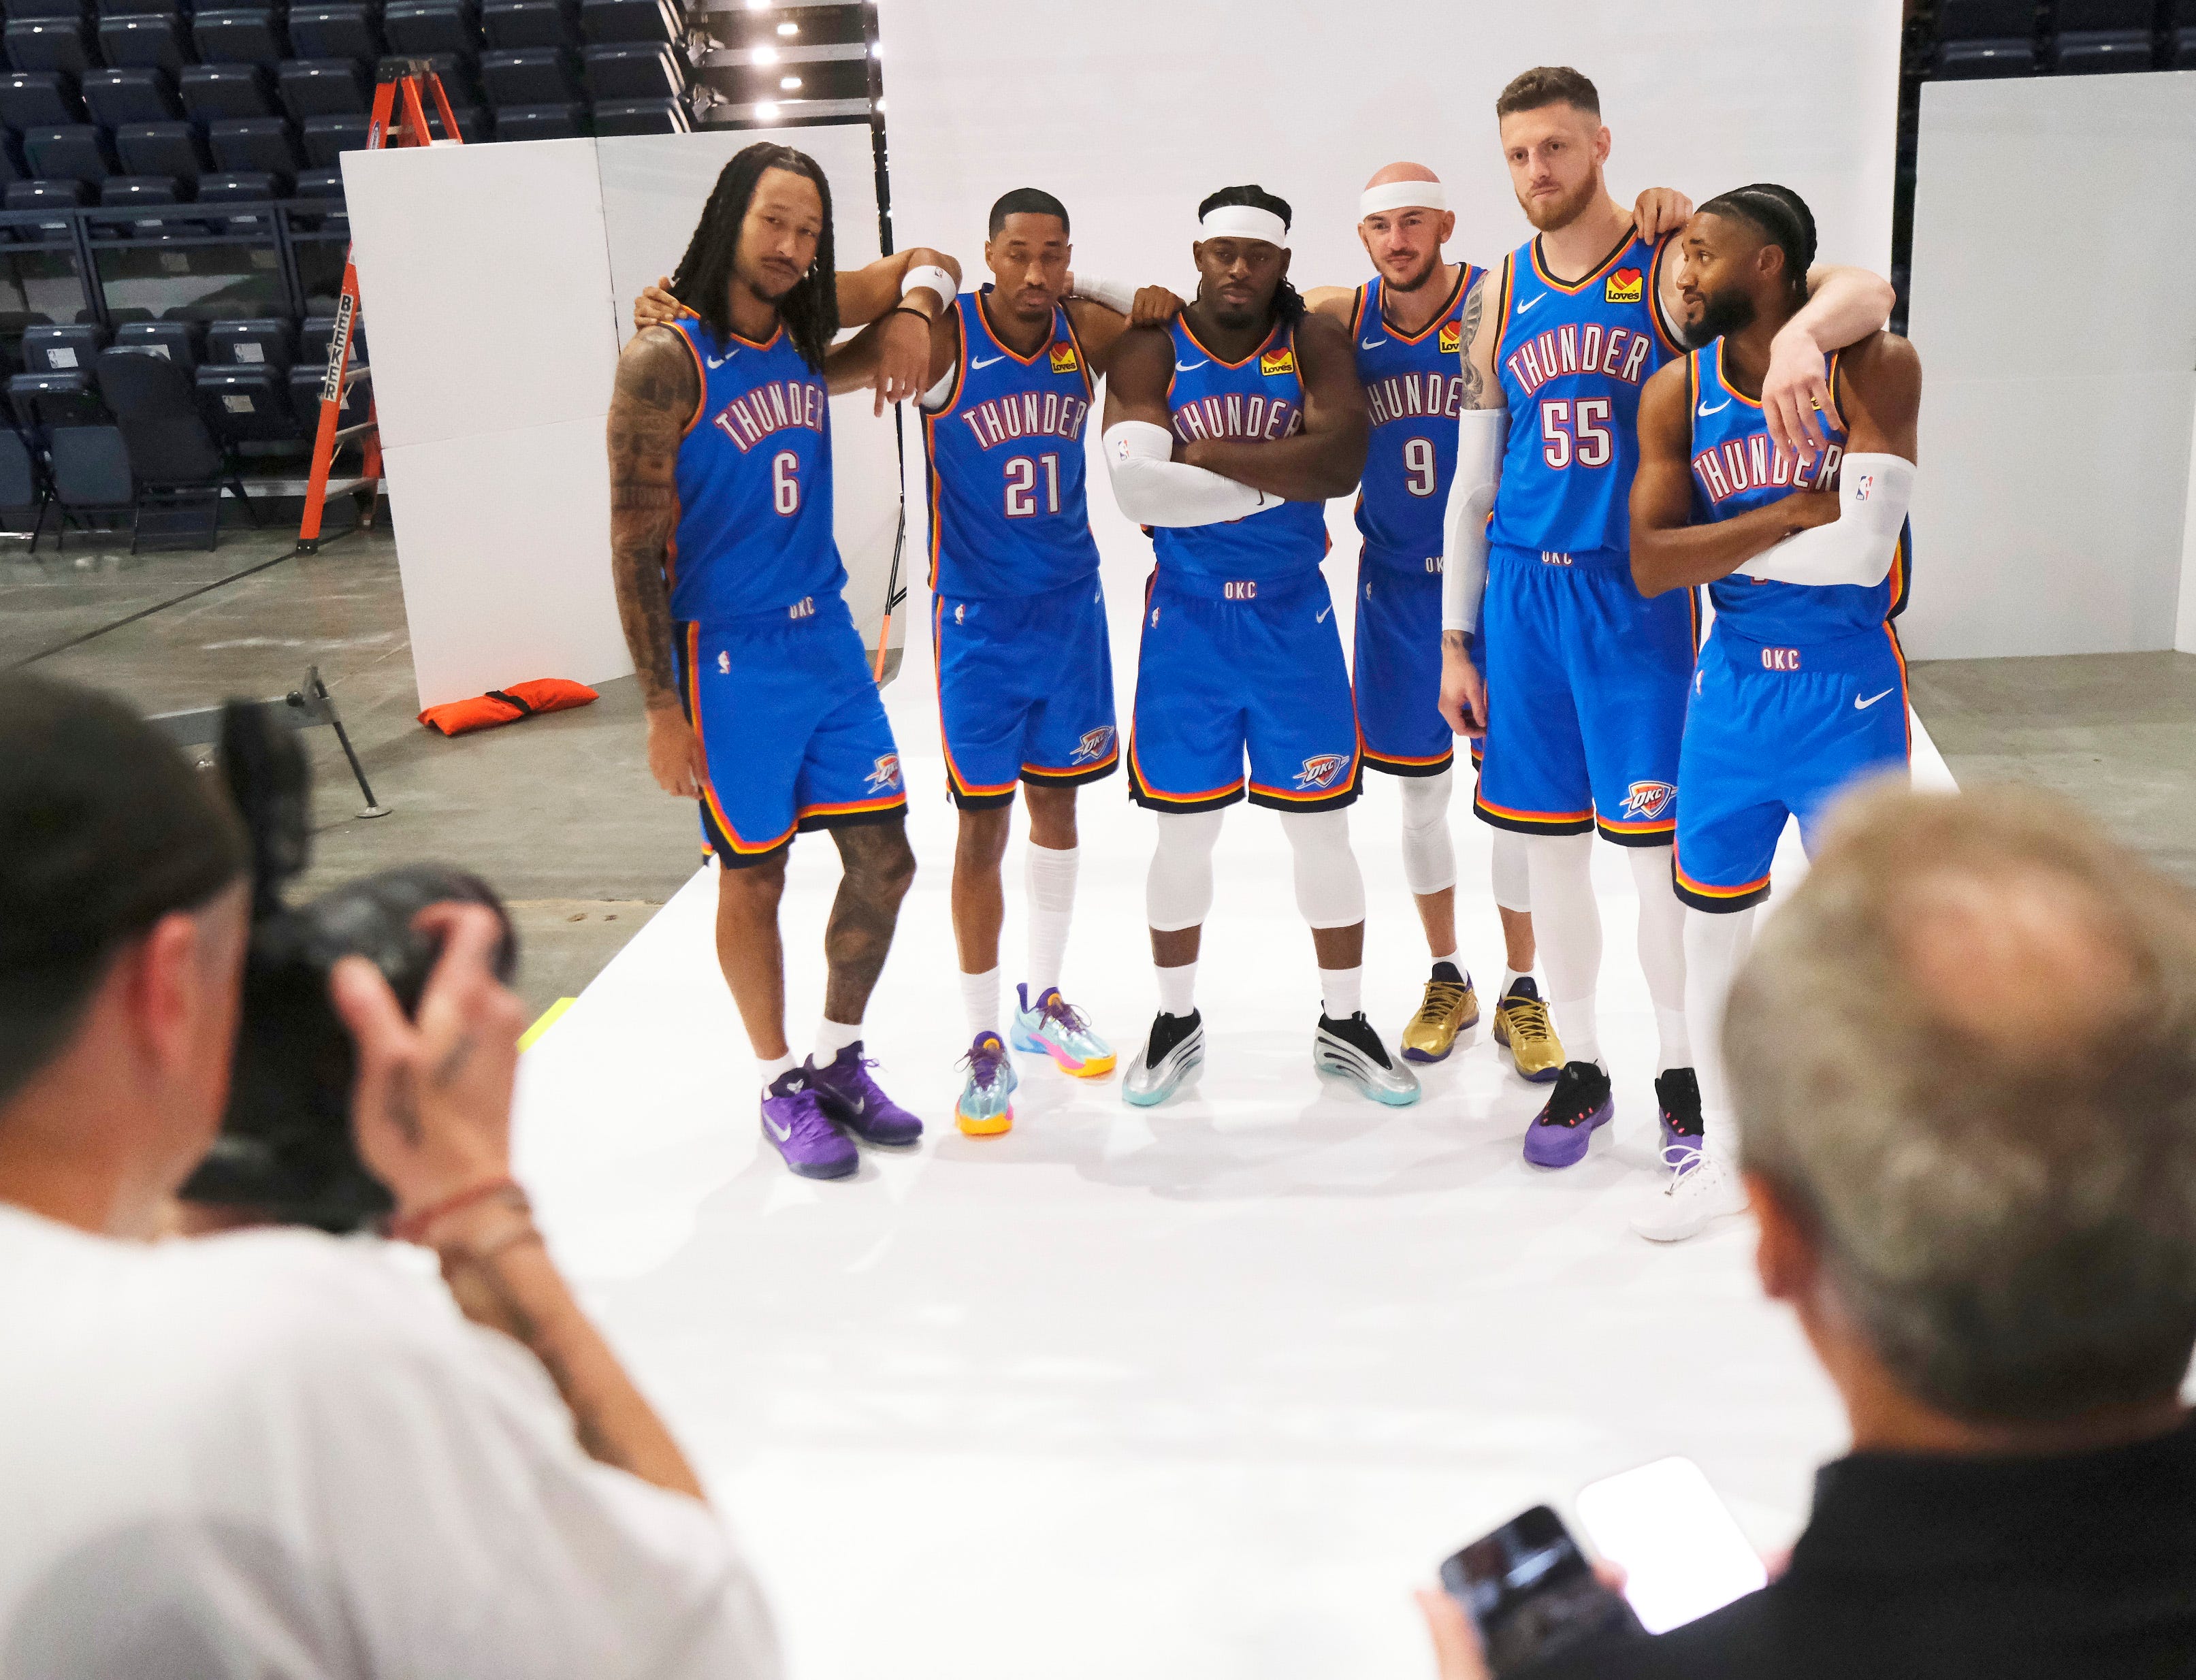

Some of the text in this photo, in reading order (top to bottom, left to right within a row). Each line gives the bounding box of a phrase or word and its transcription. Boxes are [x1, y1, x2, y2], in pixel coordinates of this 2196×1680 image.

[325, 295, 351, 400] BEEKER
[1441, 342, 1459, 351] Lov
[1507, 323, 1651, 397] THUNDER
[713, 381, 824, 454] THUNDER
[960, 390, 1088, 451] THUNDER
[1366, 371, 1462, 428] HUNDE
[1541, 397, 1612, 469] 55
[771, 449, 800, 517] 6
[1004, 453, 1061, 519] 21
[1402, 436, 1437, 498] 9
[1224, 581, 1257, 599] OKC
[1425, 555, 1443, 572] OK
[1762, 647, 1799, 671] OKC
[1631, 788, 1662, 810] OKC
